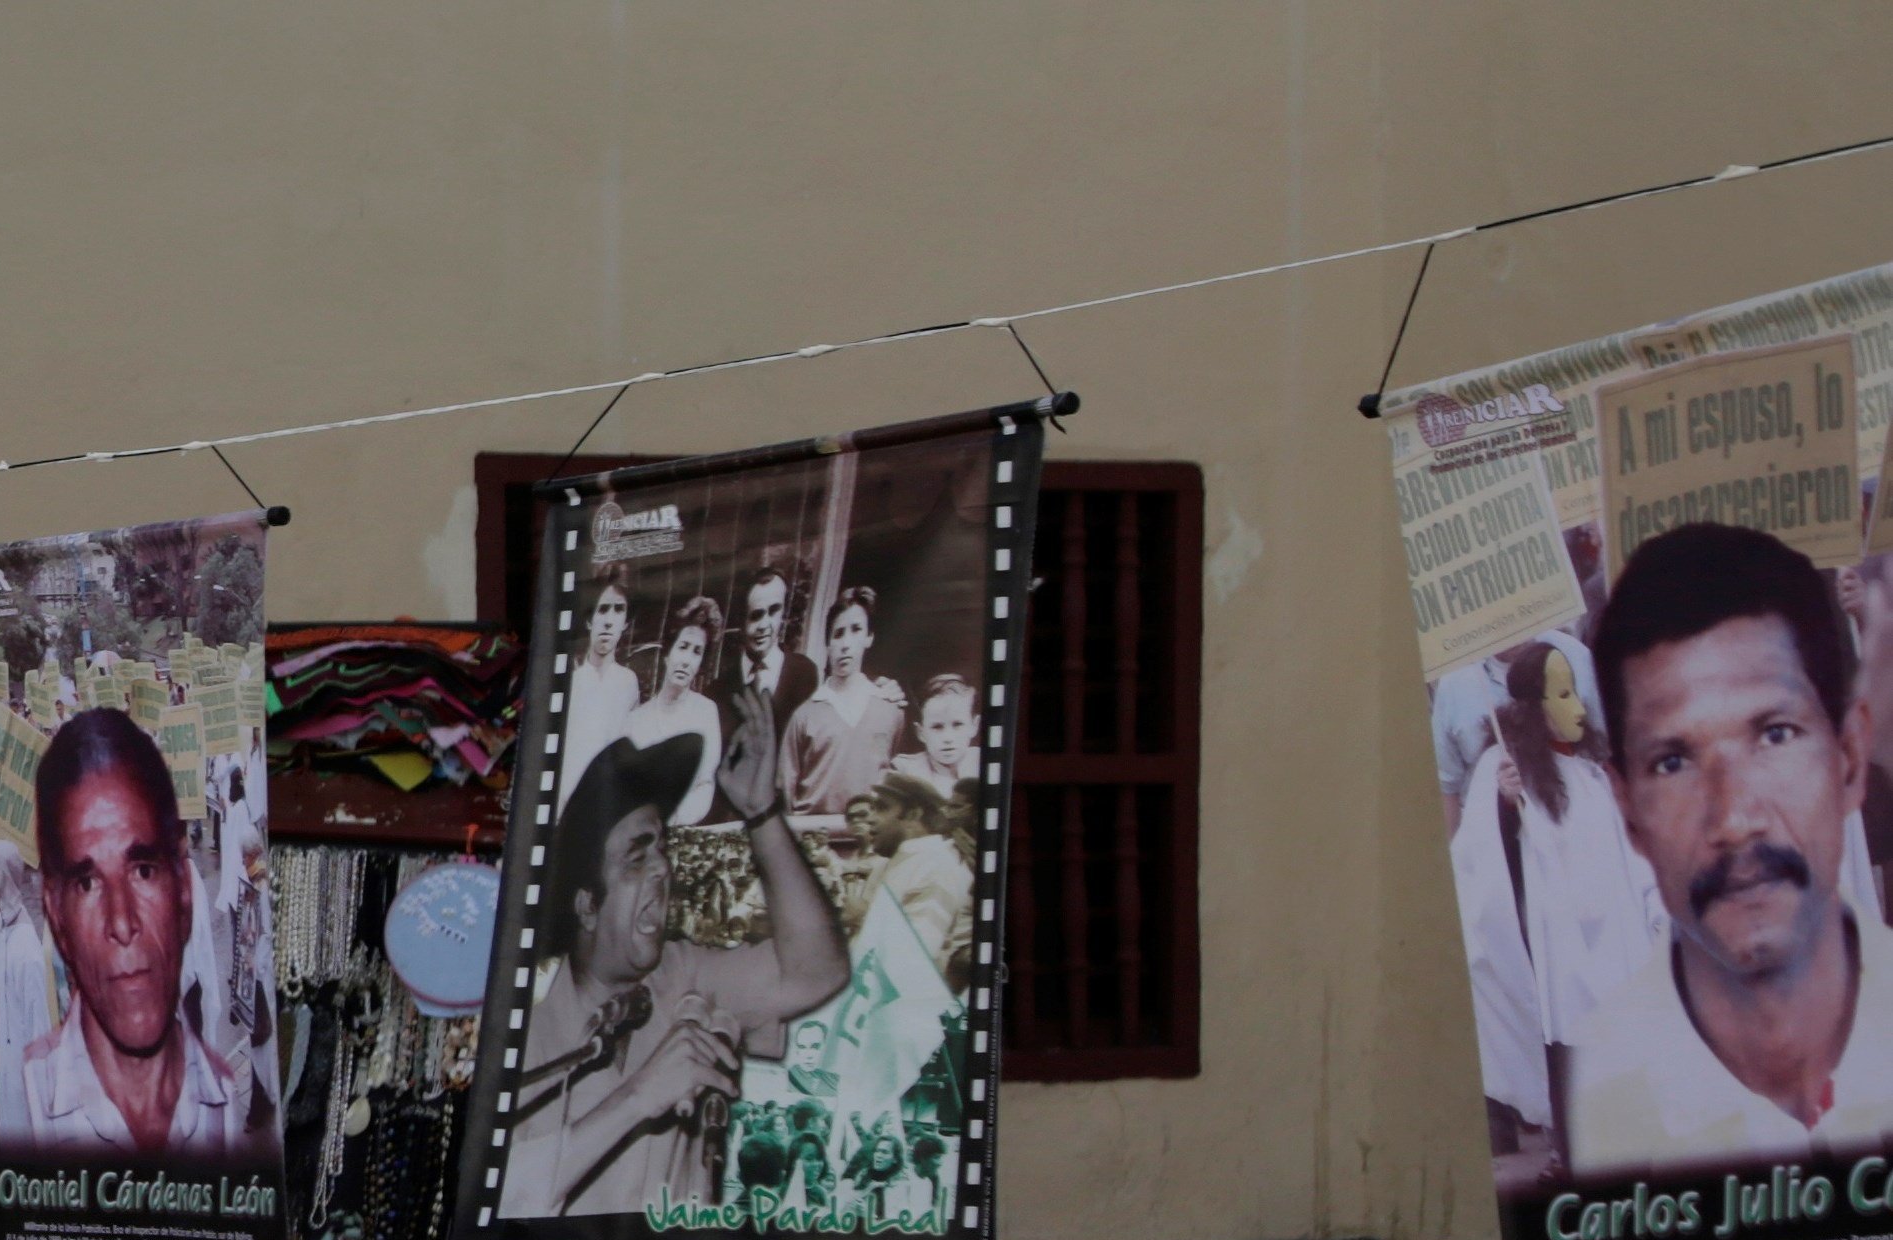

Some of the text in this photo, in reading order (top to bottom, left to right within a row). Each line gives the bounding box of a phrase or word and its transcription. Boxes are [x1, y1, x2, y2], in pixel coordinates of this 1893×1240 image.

[1618, 405, 1637, 476] A
[1645, 391, 1679, 467] mi
[1687, 381, 1805, 460] esposo,
[1814, 363, 1845, 433] lo
[1468, 481, 1545, 548] CONTRA
[1439, 530, 1561, 621] PATRIÓTICA
[96, 1169, 213, 1214] Cárdenas
[219, 1174, 277, 1217] León
[645, 1185, 949, 1235] Jaime Pardo Leal
[1713, 1165, 1836, 1240] Julio
